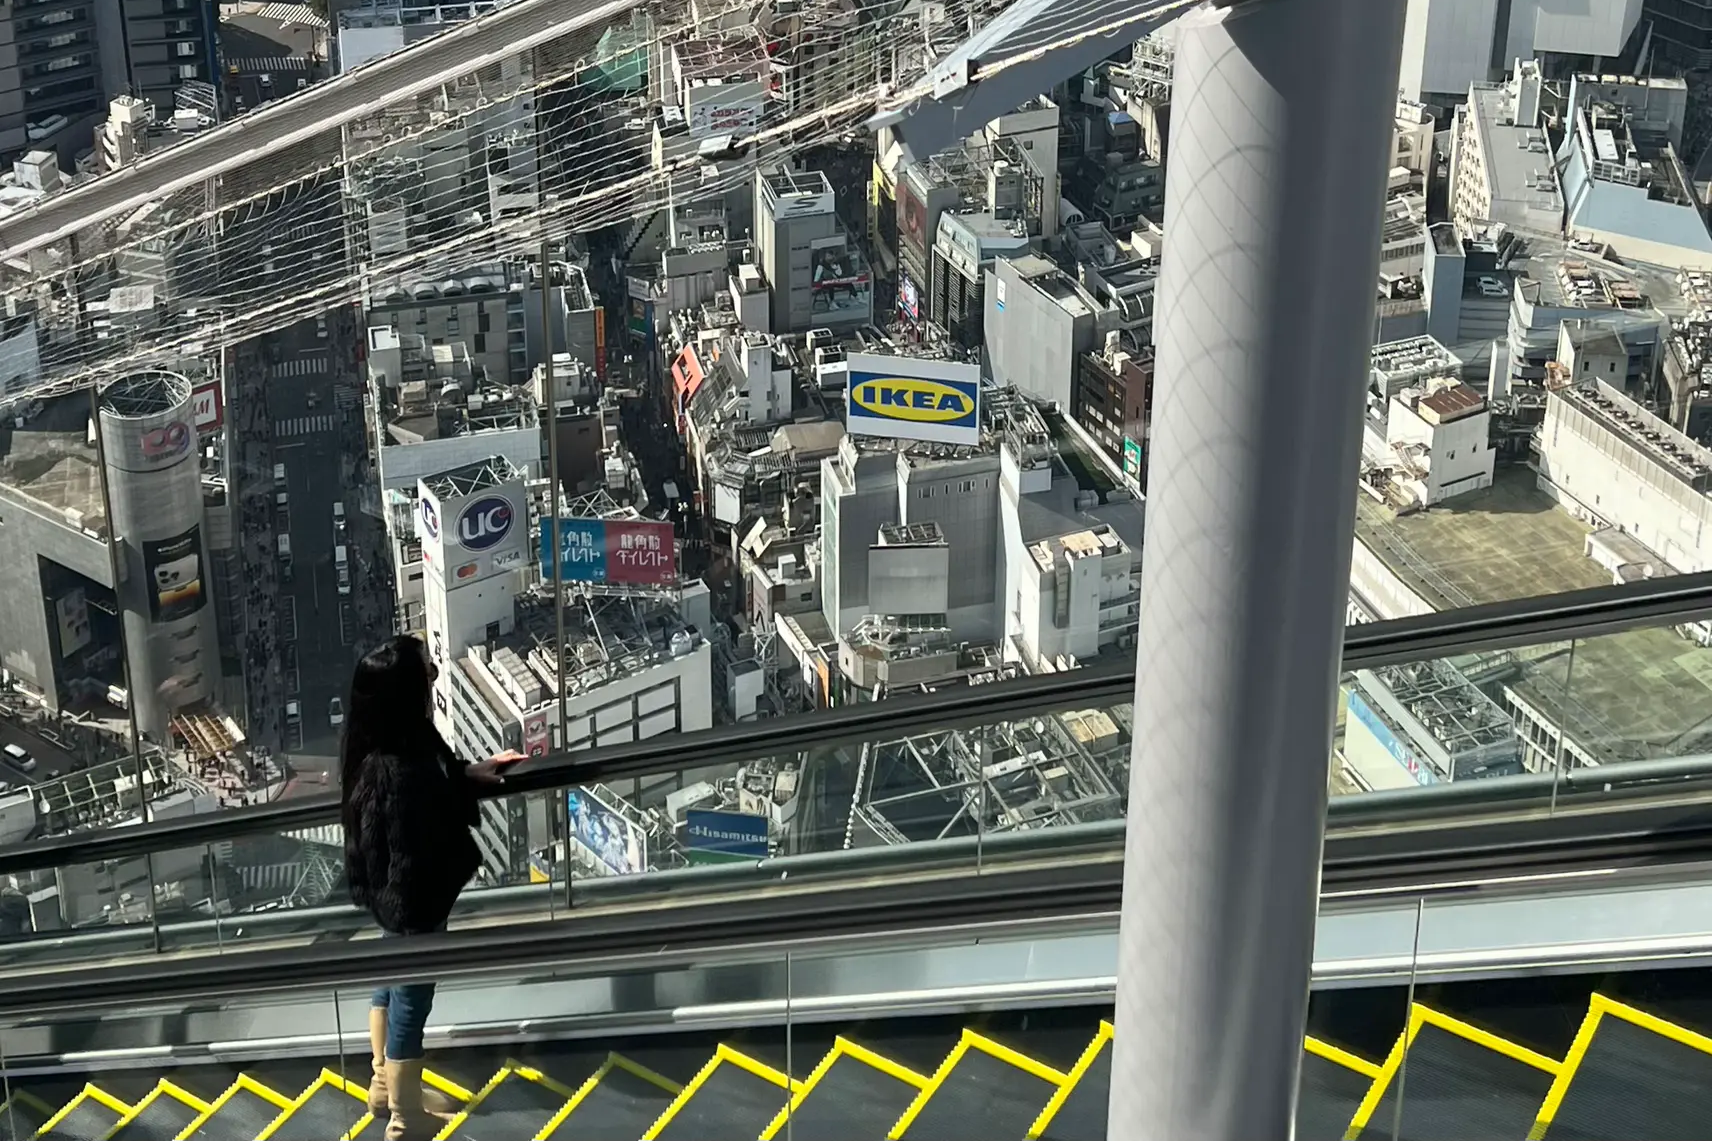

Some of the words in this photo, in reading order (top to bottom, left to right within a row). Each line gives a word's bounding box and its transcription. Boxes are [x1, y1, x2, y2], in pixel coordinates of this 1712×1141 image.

[863, 386, 967, 412] IKEA
[495, 551, 520, 565] VISA
[560, 547, 601, 563] イレクト
[689, 825, 768, 843] Hisamitsu
